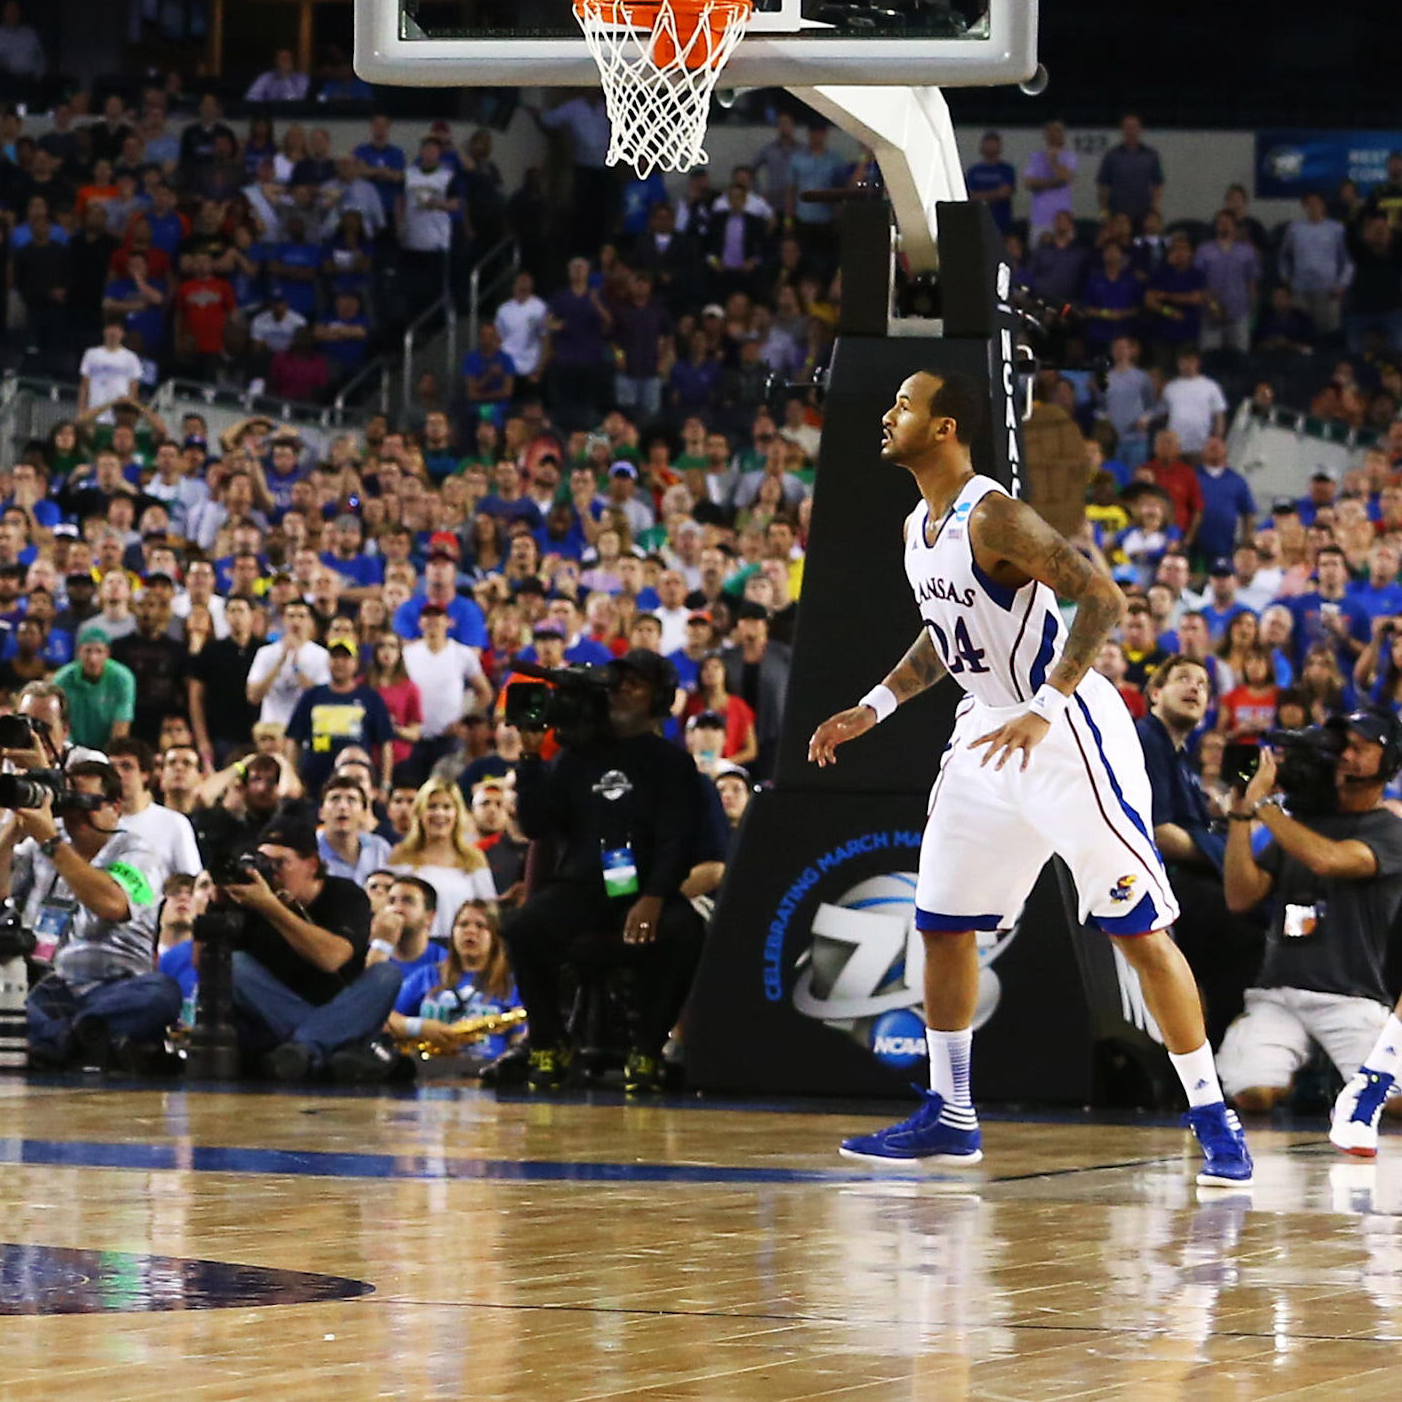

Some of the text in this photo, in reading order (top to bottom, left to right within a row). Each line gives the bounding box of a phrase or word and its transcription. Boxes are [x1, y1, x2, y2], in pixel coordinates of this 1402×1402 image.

[917, 576, 976, 608] ANSAS
[924, 615, 991, 674] 24
[763, 830, 889, 1002] CELEBRATING MARCH
